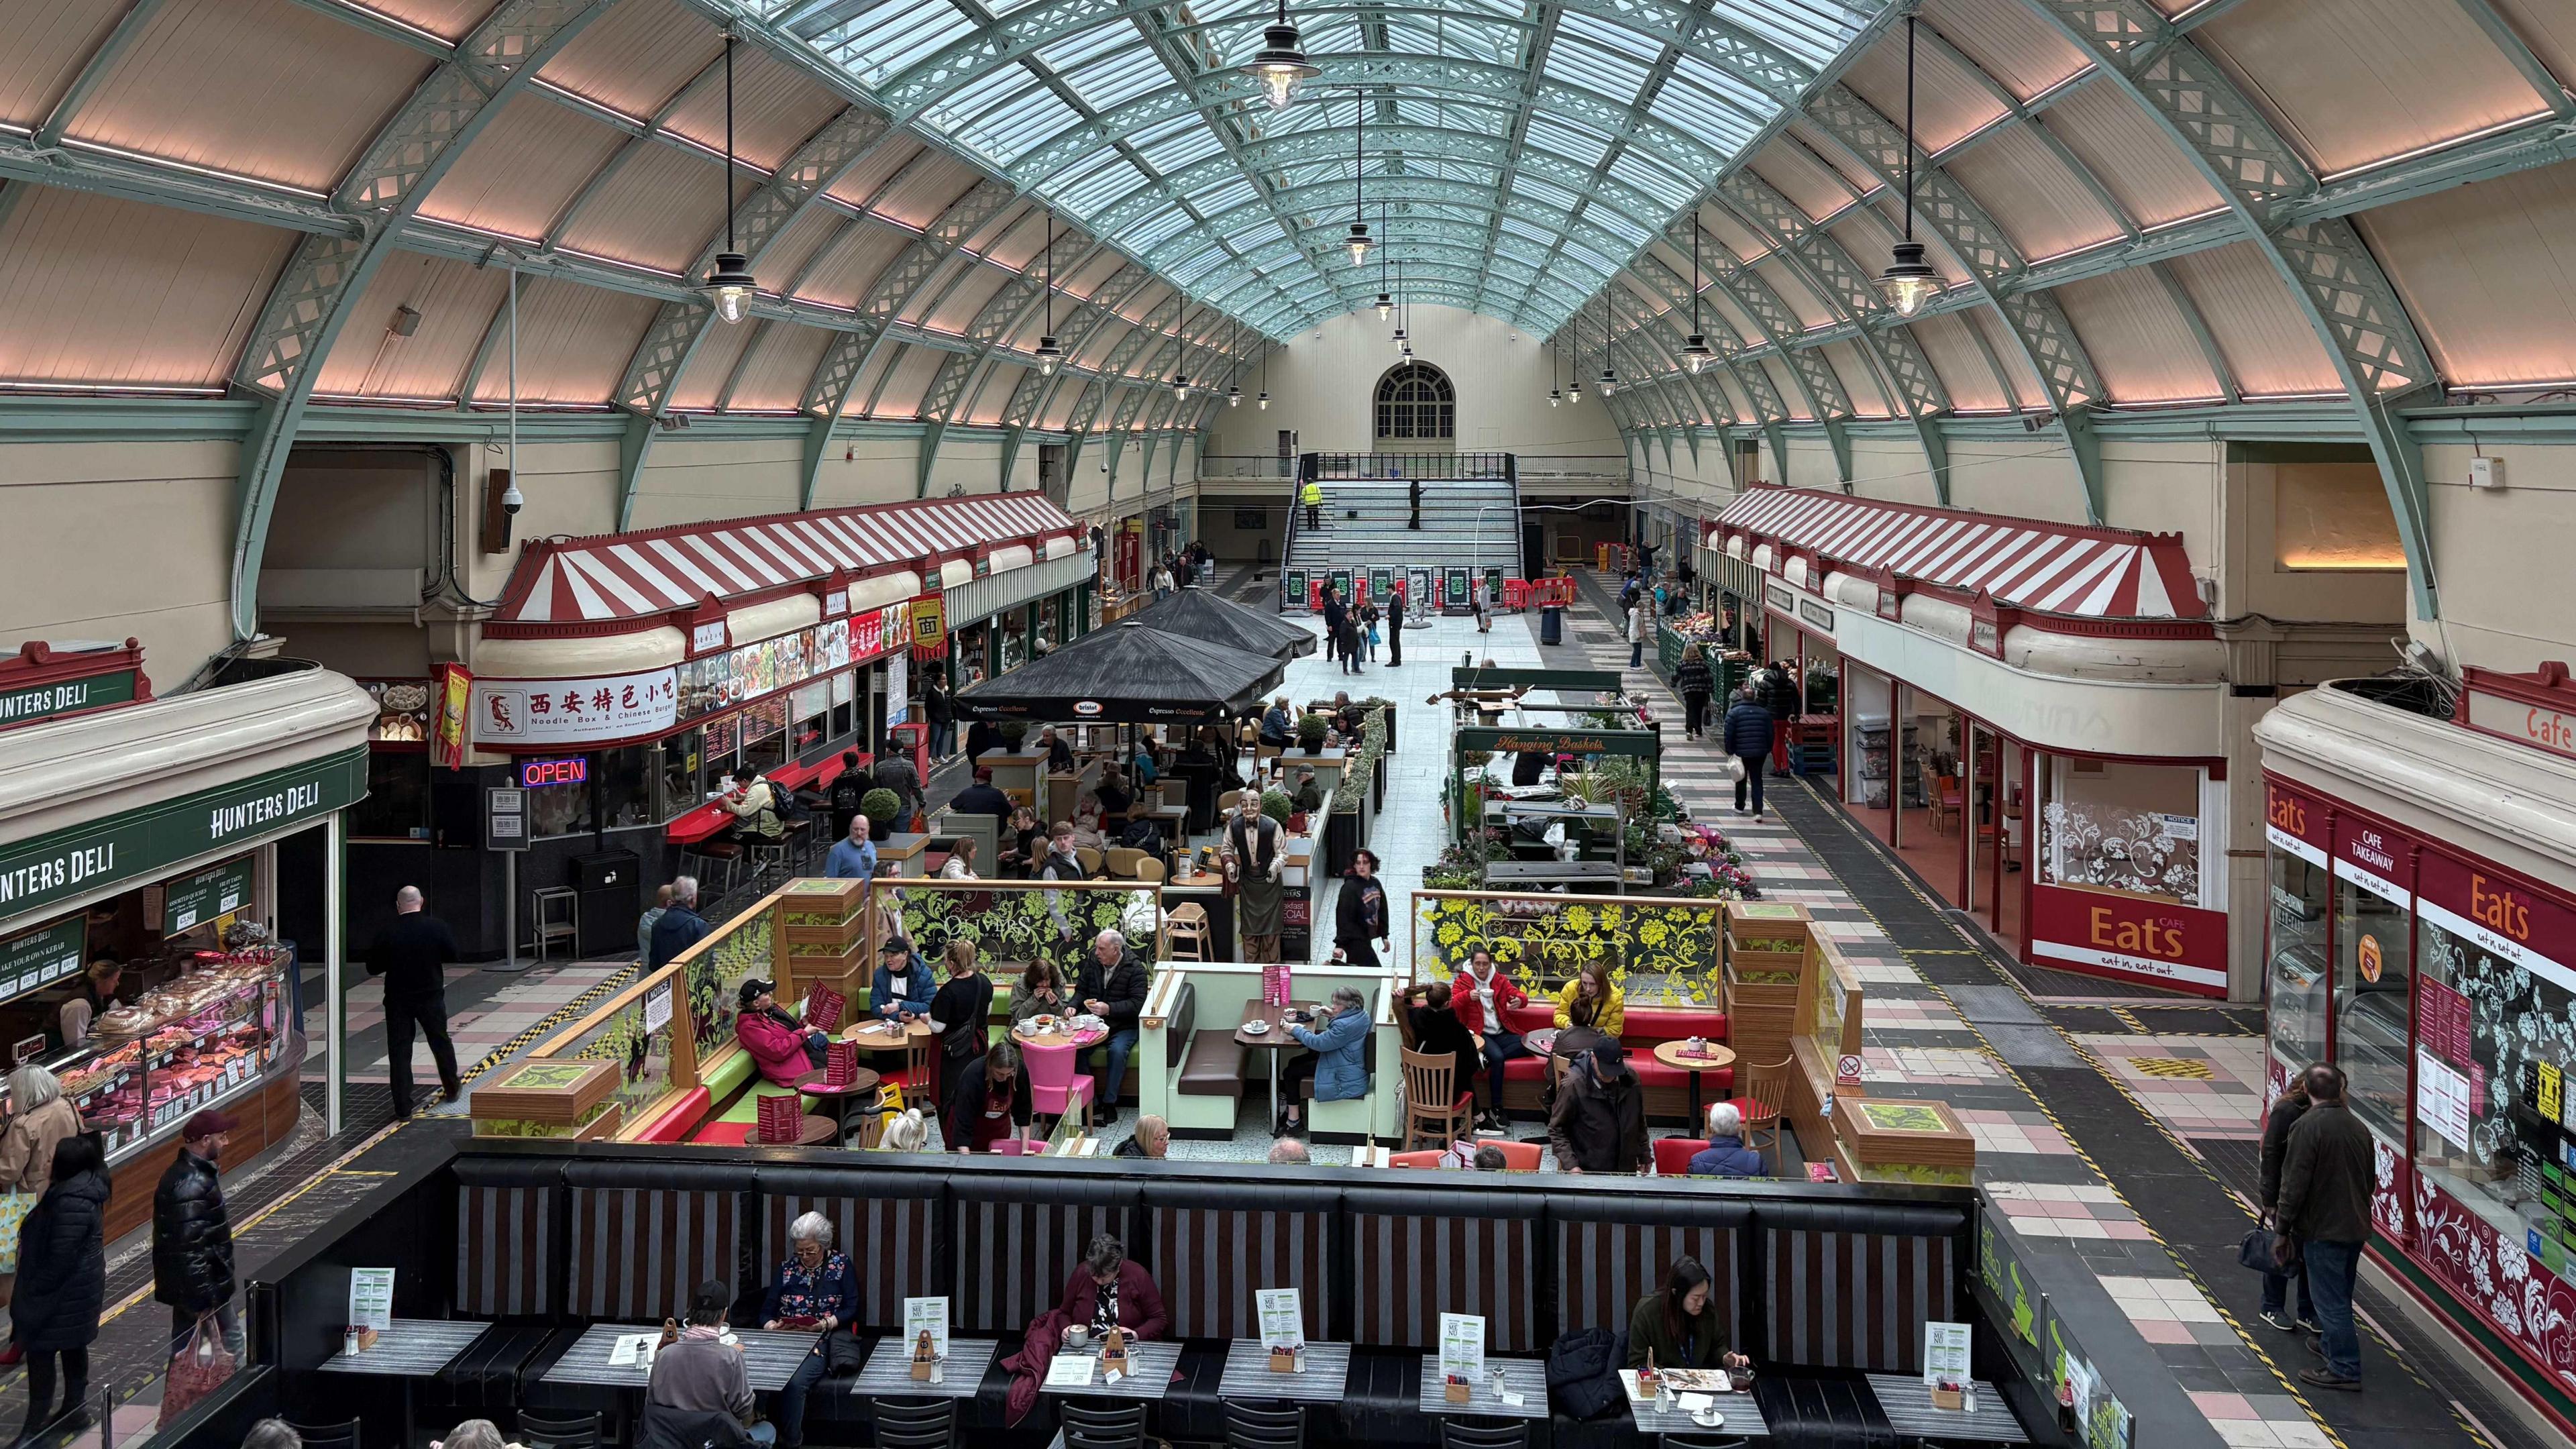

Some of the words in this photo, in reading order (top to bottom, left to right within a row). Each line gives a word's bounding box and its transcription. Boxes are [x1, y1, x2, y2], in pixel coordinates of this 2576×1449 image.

[55, 684, 87, 710] DELI
[530, 676, 674, 714] 西安特色小吃
[531, 715, 569, 724] Noodle
[618, 709, 651, 720] Chinese
[655, 703, 673, 714] Burger
[2527, 708, 2571, 749] Cafe
[1494, 735, 1554, 753] Hanging
[1556, 736, 1606, 751] Baskets
[526, 761, 584, 784] OPEN
[210, 794, 283, 839] HUNTERS
[287, 782, 319, 816] DELI
[2269, 785, 2306, 836] Eats
[2363, 830, 2382, 850] CAFE
[70, 843, 114, 884] DELI
[2351, 842, 2394, 872] TAKEAWAY
[215, 867, 226, 878] DELI
[2354, 871, 2364, 881] eat
[2371, 877, 2379, 890] eat
[2472, 873, 2529, 940] Eats
[2091, 906, 2184, 958] Eats
[2159, 917, 2185, 930] CAFE
[12, 936, 38, 953] HUNTERS
[38, 930, 51, 942] DELI
[2477, 932, 2488, 945] eat
[2498, 942, 2510, 954] eat
[2510, 947, 2523, 962] out.
[13, 955, 30, 967] YOUR
[30, 950, 44, 961] OWN
[46, 942, 65, 955] KEBAB
[2102, 955, 2120, 966] eat
[2122, 959, 2133, 970] in,
[2135, 962, 2155, 972] eat
[2157, 965, 2175, 976] out.
[650, 981, 668, 999] NOTICE
